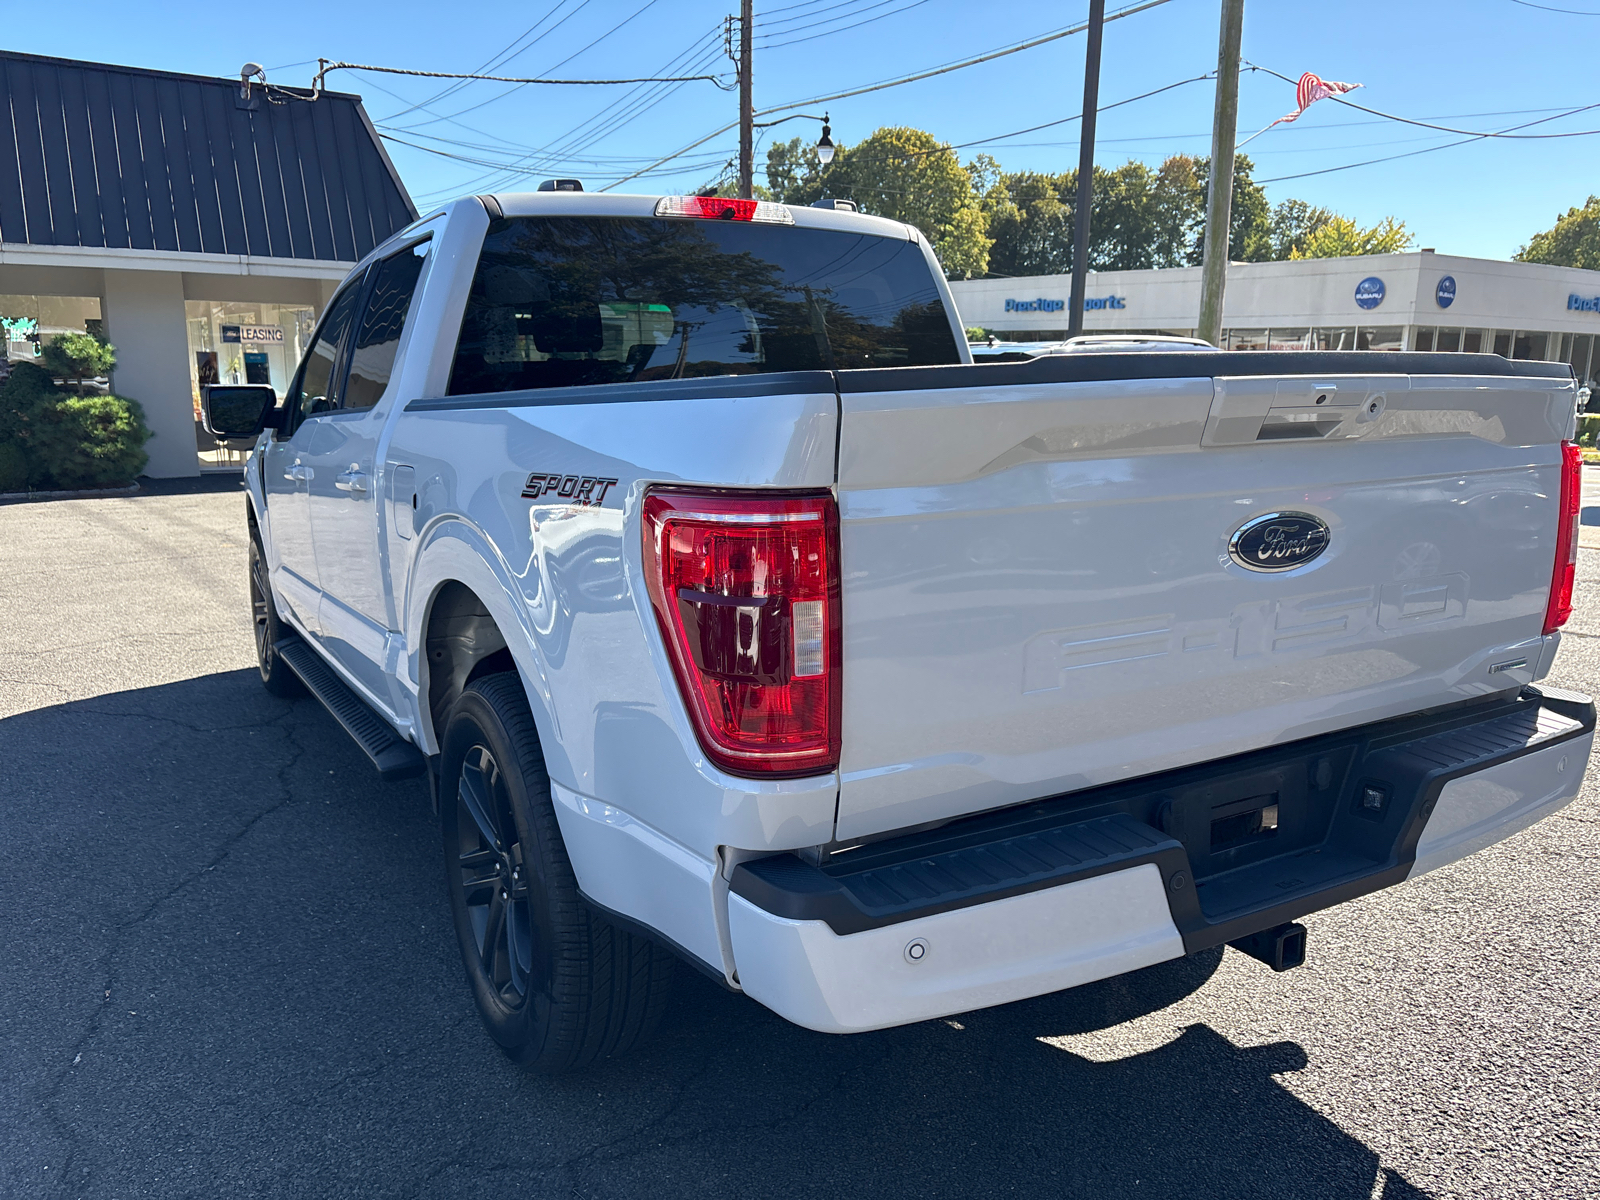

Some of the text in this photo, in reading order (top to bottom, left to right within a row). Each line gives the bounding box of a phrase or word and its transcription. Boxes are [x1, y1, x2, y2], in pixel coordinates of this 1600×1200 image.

[1004, 295, 1126, 312] Prestige Iports
[241, 328, 283, 341] LEASING
[521, 472, 619, 501] SPORT
[1258, 525, 1311, 560] Ford
[1021, 570, 1470, 695] F-150
